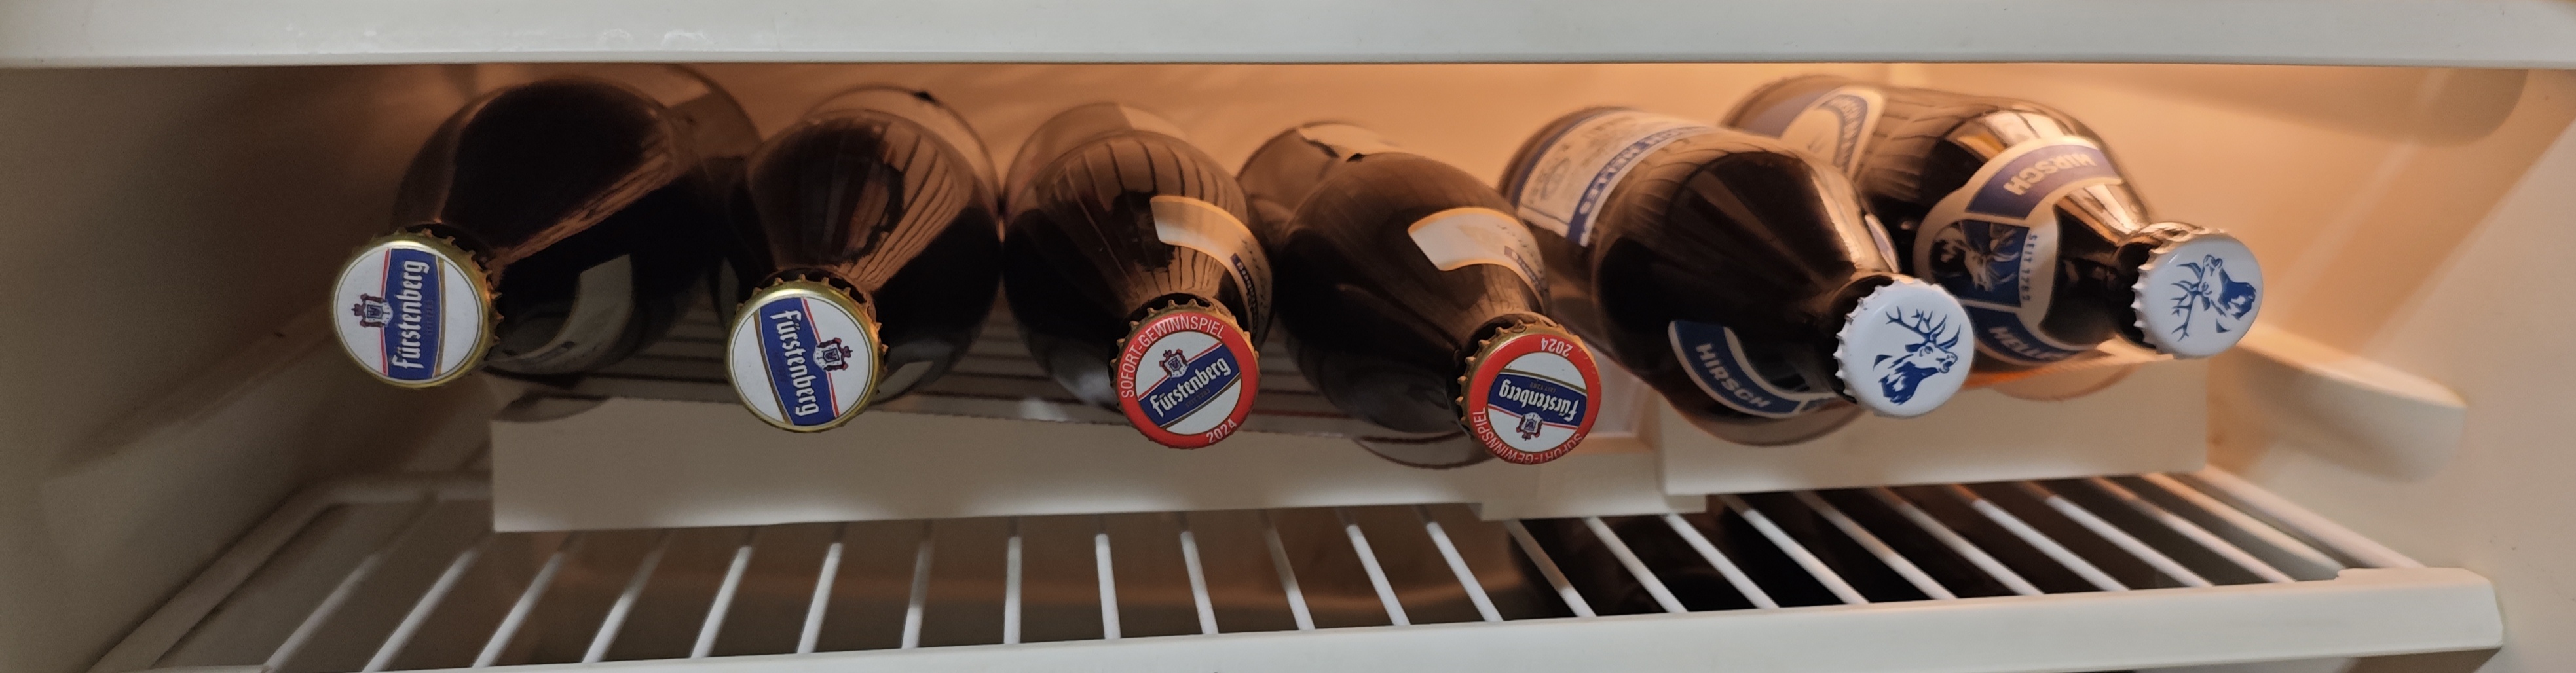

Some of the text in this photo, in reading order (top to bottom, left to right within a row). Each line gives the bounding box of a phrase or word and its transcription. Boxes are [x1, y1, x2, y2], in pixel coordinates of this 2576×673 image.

[2003, 153, 2097, 196] HIRSCH
[1120, 314, 1226, 399] SOFORT-GEWINNSPIEL
[1540, 337, 1573, 357] 2024
[1696, 343, 1771, 407] HIRSCH
[1206, 418, 1237, 443] 2024
